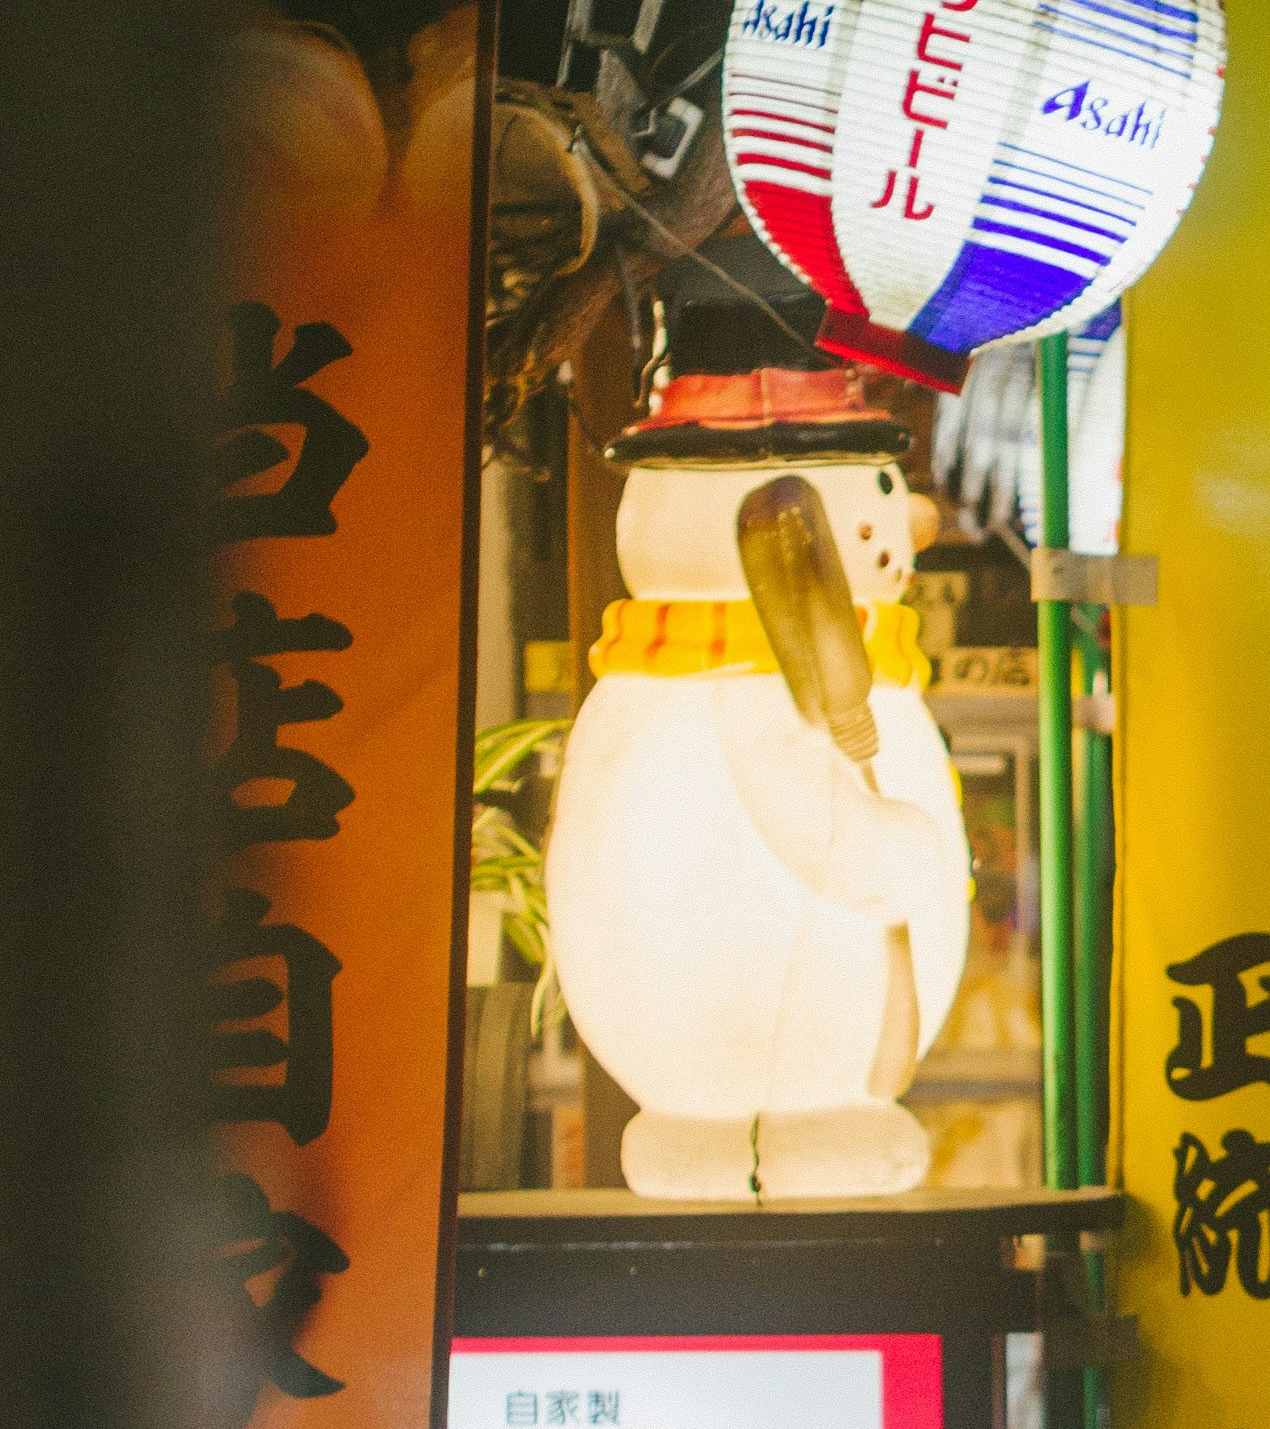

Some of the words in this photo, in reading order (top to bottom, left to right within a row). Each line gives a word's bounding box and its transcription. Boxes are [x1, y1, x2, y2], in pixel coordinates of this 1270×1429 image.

[1042, 78, 1167, 151] Asahi
[505, 1390, 621, 1426] 自家製
